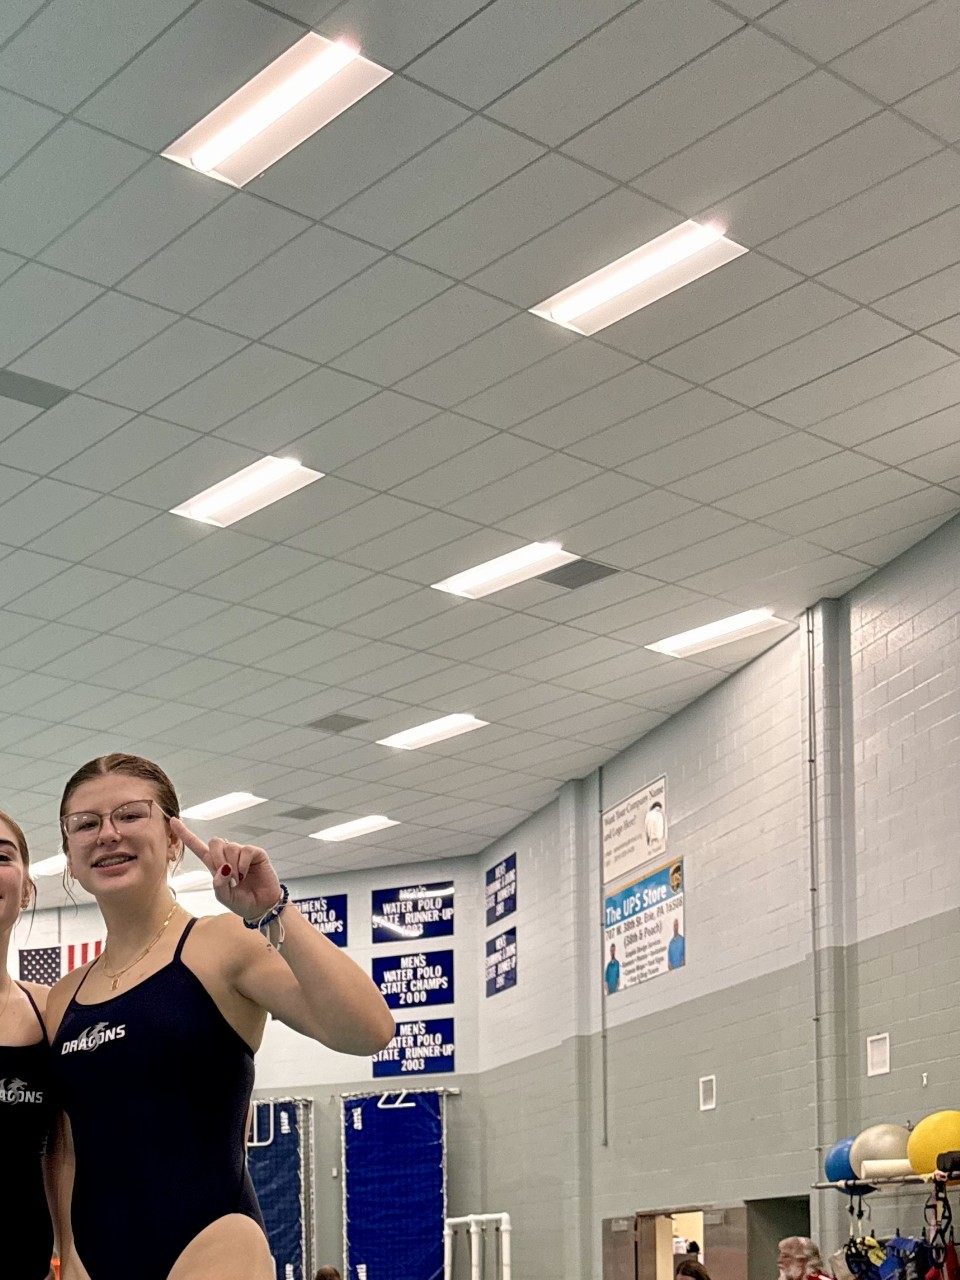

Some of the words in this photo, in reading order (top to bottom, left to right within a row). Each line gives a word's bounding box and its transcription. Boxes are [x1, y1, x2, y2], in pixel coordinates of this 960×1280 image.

[296, 896, 327, 912] OMEN'S
[383, 901, 412, 914] WATER
[418, 898, 442, 911] POLO
[606, 906, 621, 925] The
[623, 893, 641, 916] UPS
[643, 885, 667, 908] Store
[311, 910, 336, 922] POLO
[405, 908, 454, 923] RUNNER-UP
[314, 920, 343, 934] HAMPS
[400, 953, 426, 969] MEN'S
[383, 970, 414, 982] WATER
[417, 966, 442, 979] POLO
[381, 982, 407, 995] STATE
[410, 977, 448, 992] CHAMPS
[399, 991, 426, 1005] 2000
[400, 1021, 426, 1036] MEN'S
[61, 1024, 126, 1055] DRAGONS
[387, 1037, 414, 1049] ATER
[417, 1033, 442, 1046] POLO
[372, 1048, 400, 1062] STATE
[405, 1044, 454, 1058] RUNNER-UP
[401, 1058, 425, 1071] 2003
